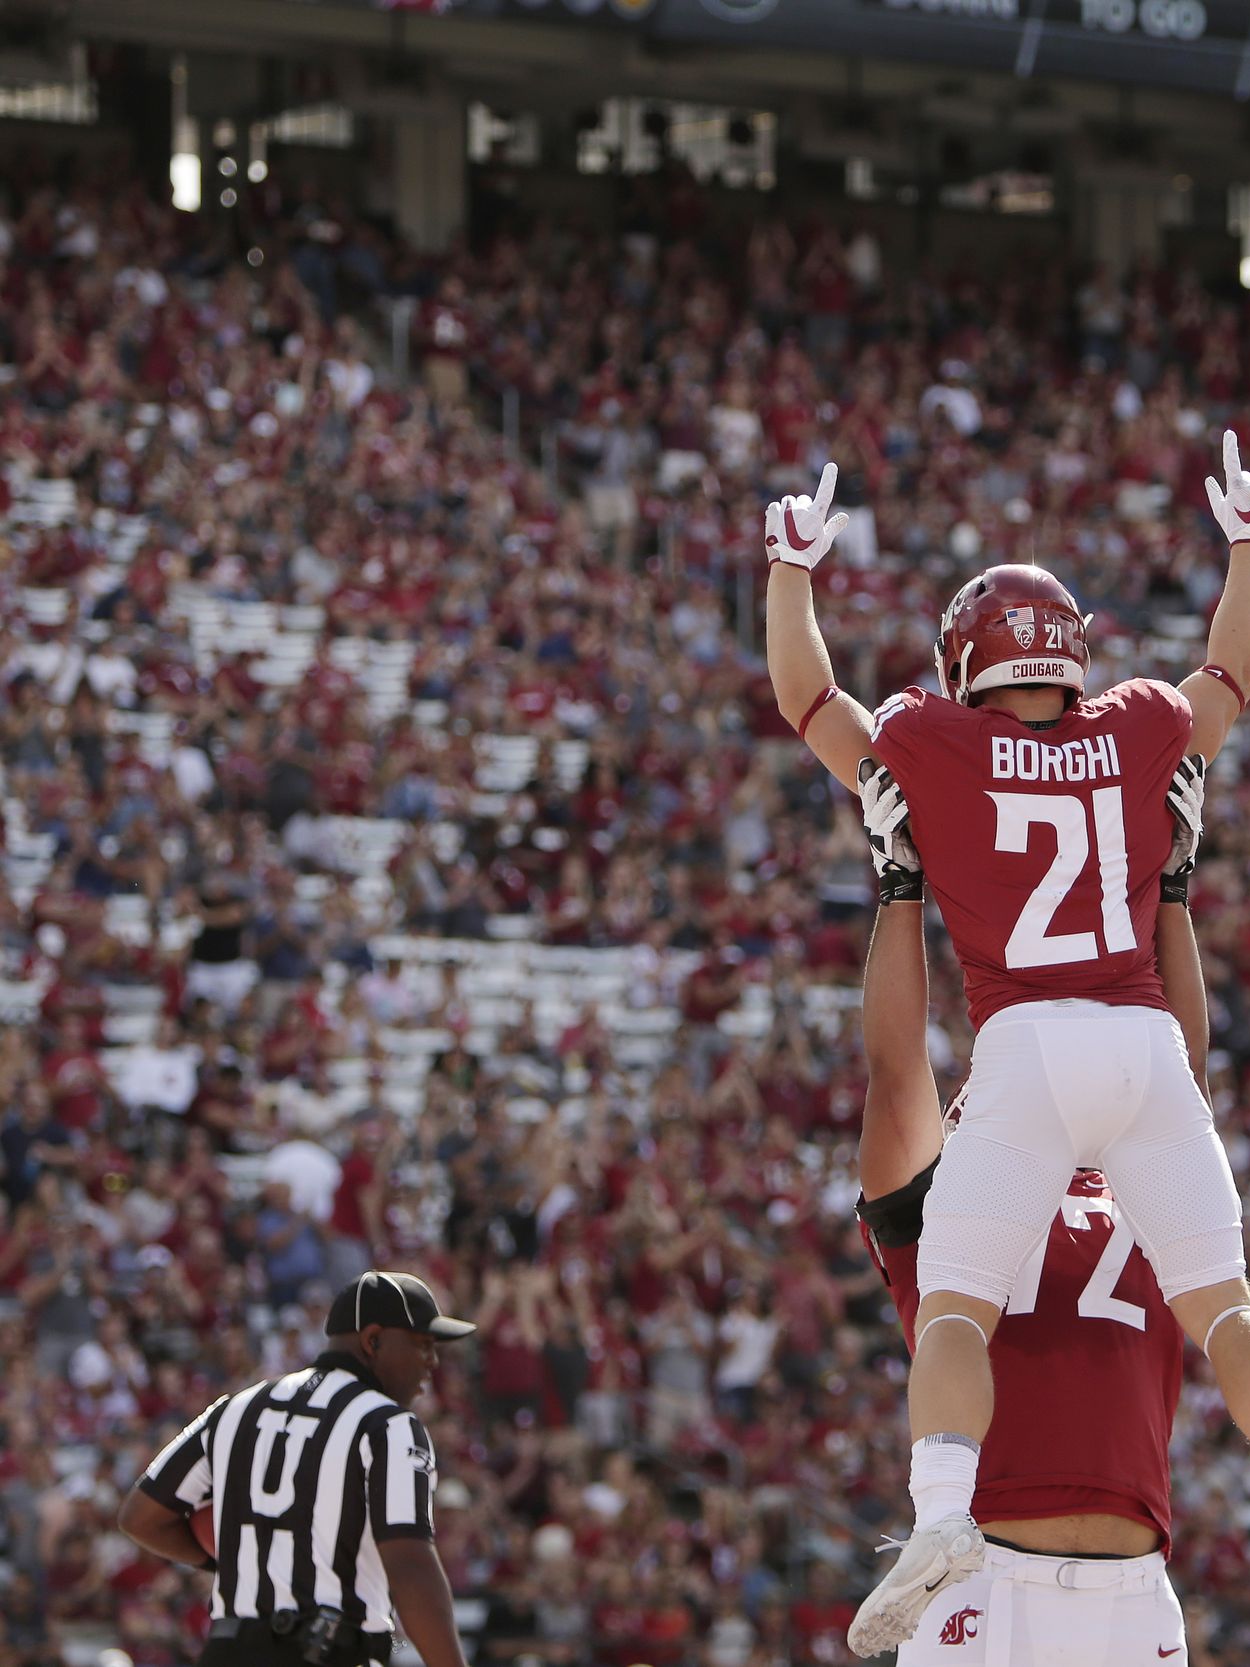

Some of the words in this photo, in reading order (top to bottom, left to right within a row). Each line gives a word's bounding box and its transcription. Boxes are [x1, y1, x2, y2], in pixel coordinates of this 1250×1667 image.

[1044, 623, 1063, 649] 21
[1012, 663, 1065, 679] COUGARS
[991, 733, 1122, 782] BORGHI
[983, 786, 1138, 969] 21
[250, 1407, 319, 1518] U
